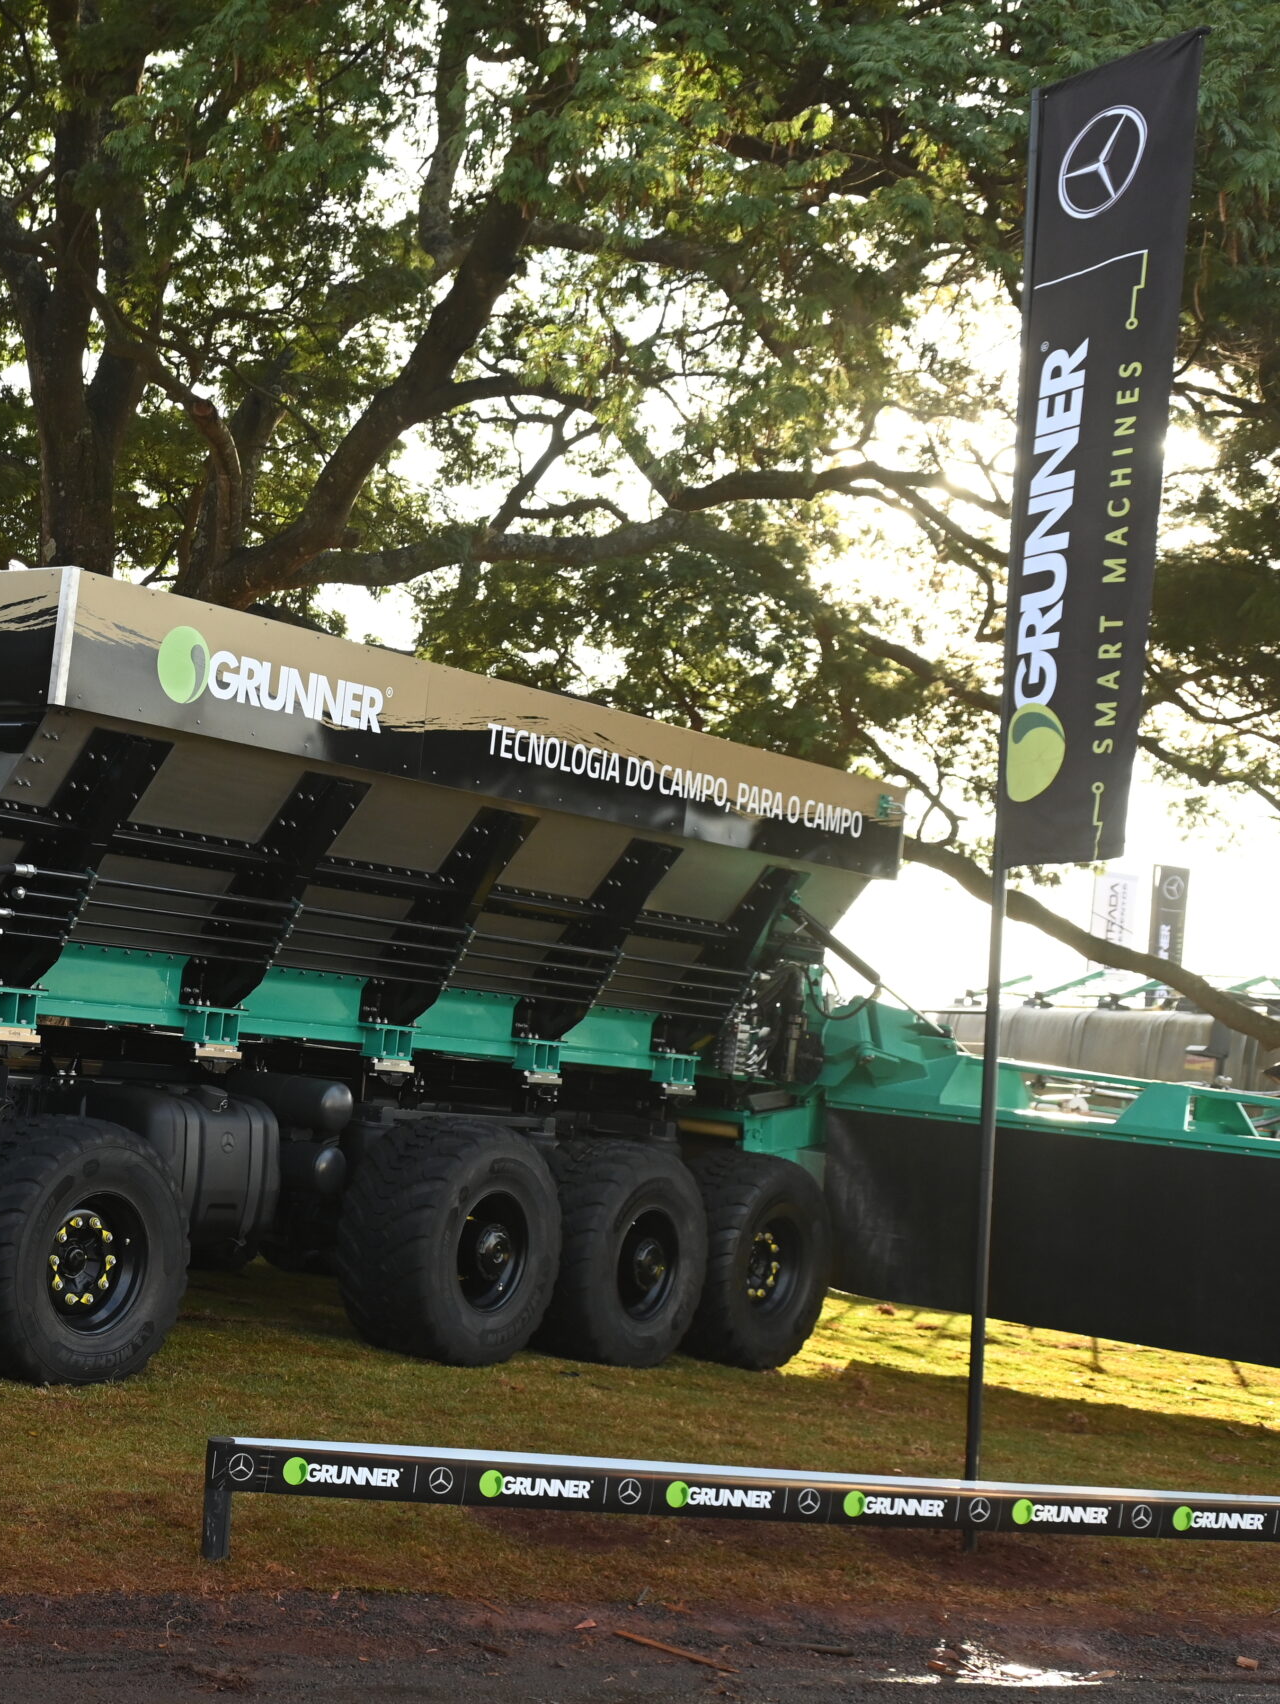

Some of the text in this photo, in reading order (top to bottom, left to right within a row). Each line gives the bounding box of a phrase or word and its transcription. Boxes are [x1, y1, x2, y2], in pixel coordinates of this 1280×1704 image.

[1014, 337, 1089, 709] GRUNNER
[1093, 361, 1144, 753] SMART MACHINES
[206, 650, 384, 734] GRUNNER
[487, 722, 863, 838] TECNOLOGIA DO CAMPO, PARA O CAMPO
[305, 1461, 400, 1488] GRUNNER
[500, 1475, 591, 1500] GRUNNER
[687, 1486, 773, 1509] GRUNNER
[863, 1496, 945, 1517] GRUNNER
[1030, 1504, 1109, 1525] GRUNNER
[1189, 1511, 1264, 1531] GRUNNER
